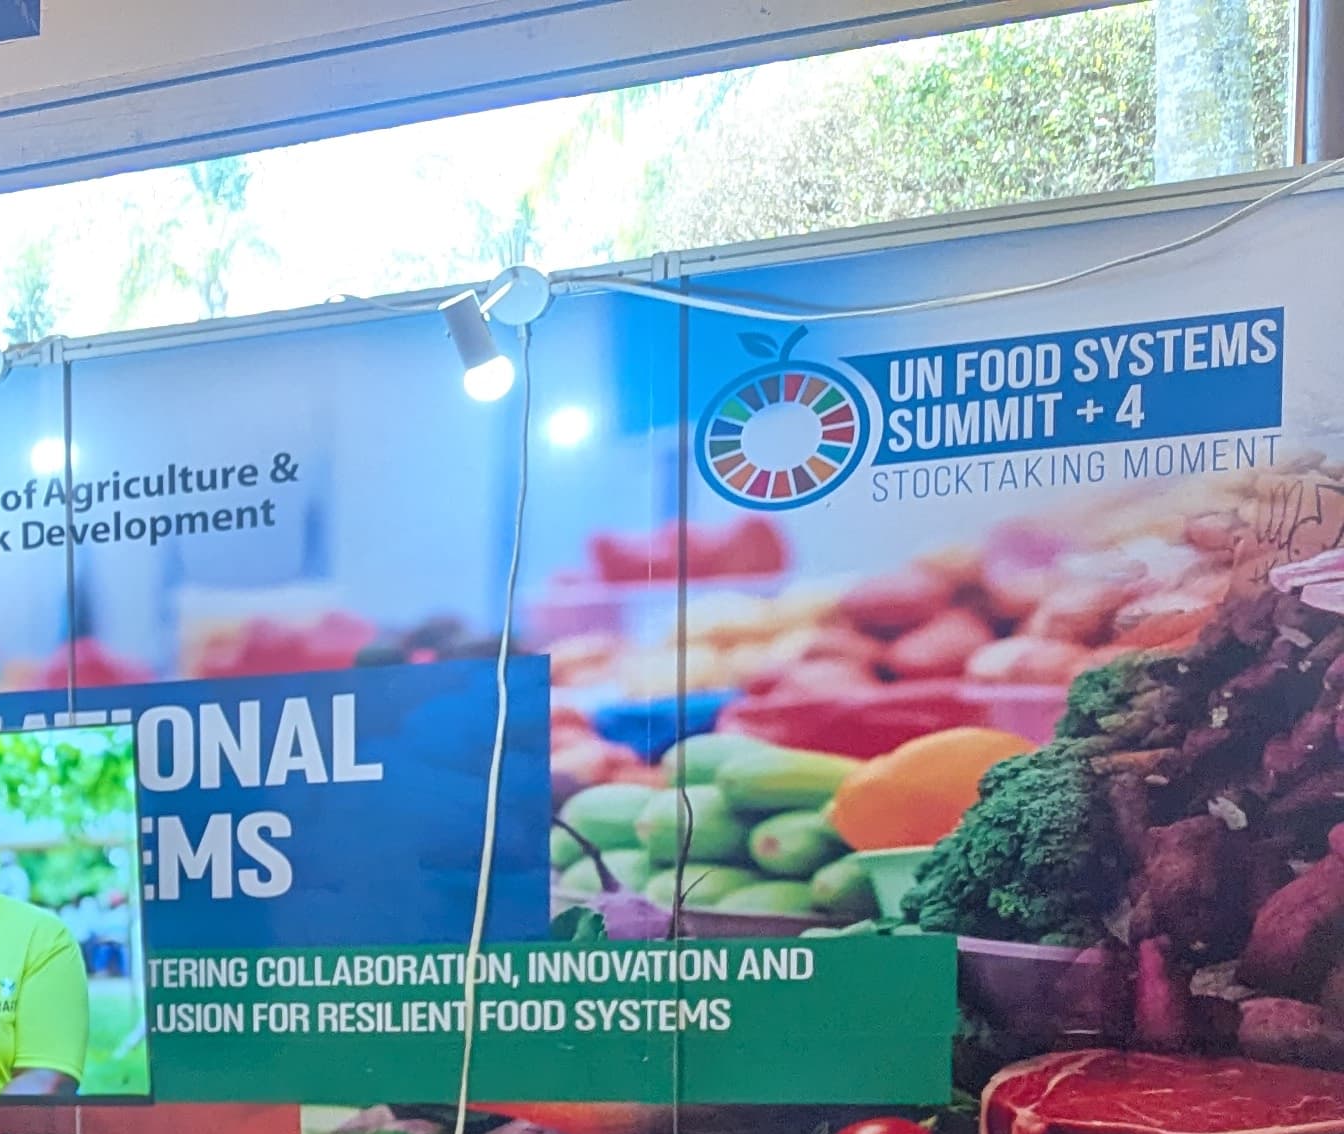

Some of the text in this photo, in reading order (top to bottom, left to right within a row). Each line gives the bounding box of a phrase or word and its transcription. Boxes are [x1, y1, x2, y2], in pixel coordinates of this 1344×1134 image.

[888, 318, 1278, 403] UN FOOD SYSTEMS
[888, 383, 1145, 453] SUMMIT + 4
[0, 478, 39, 511] of
[42, 463, 260, 514] Agriculture
[269, 452, 300, 483] &
[872, 433, 1283, 502] STOCKTAKING MOMENT
[21, 498, 277, 551] Development
[147, 947, 814, 989] TERING COLLABORATION, INNOVATION AND
[151, 998, 732, 1033] USION FOR RESILIENT FOOD SYSTEMS
